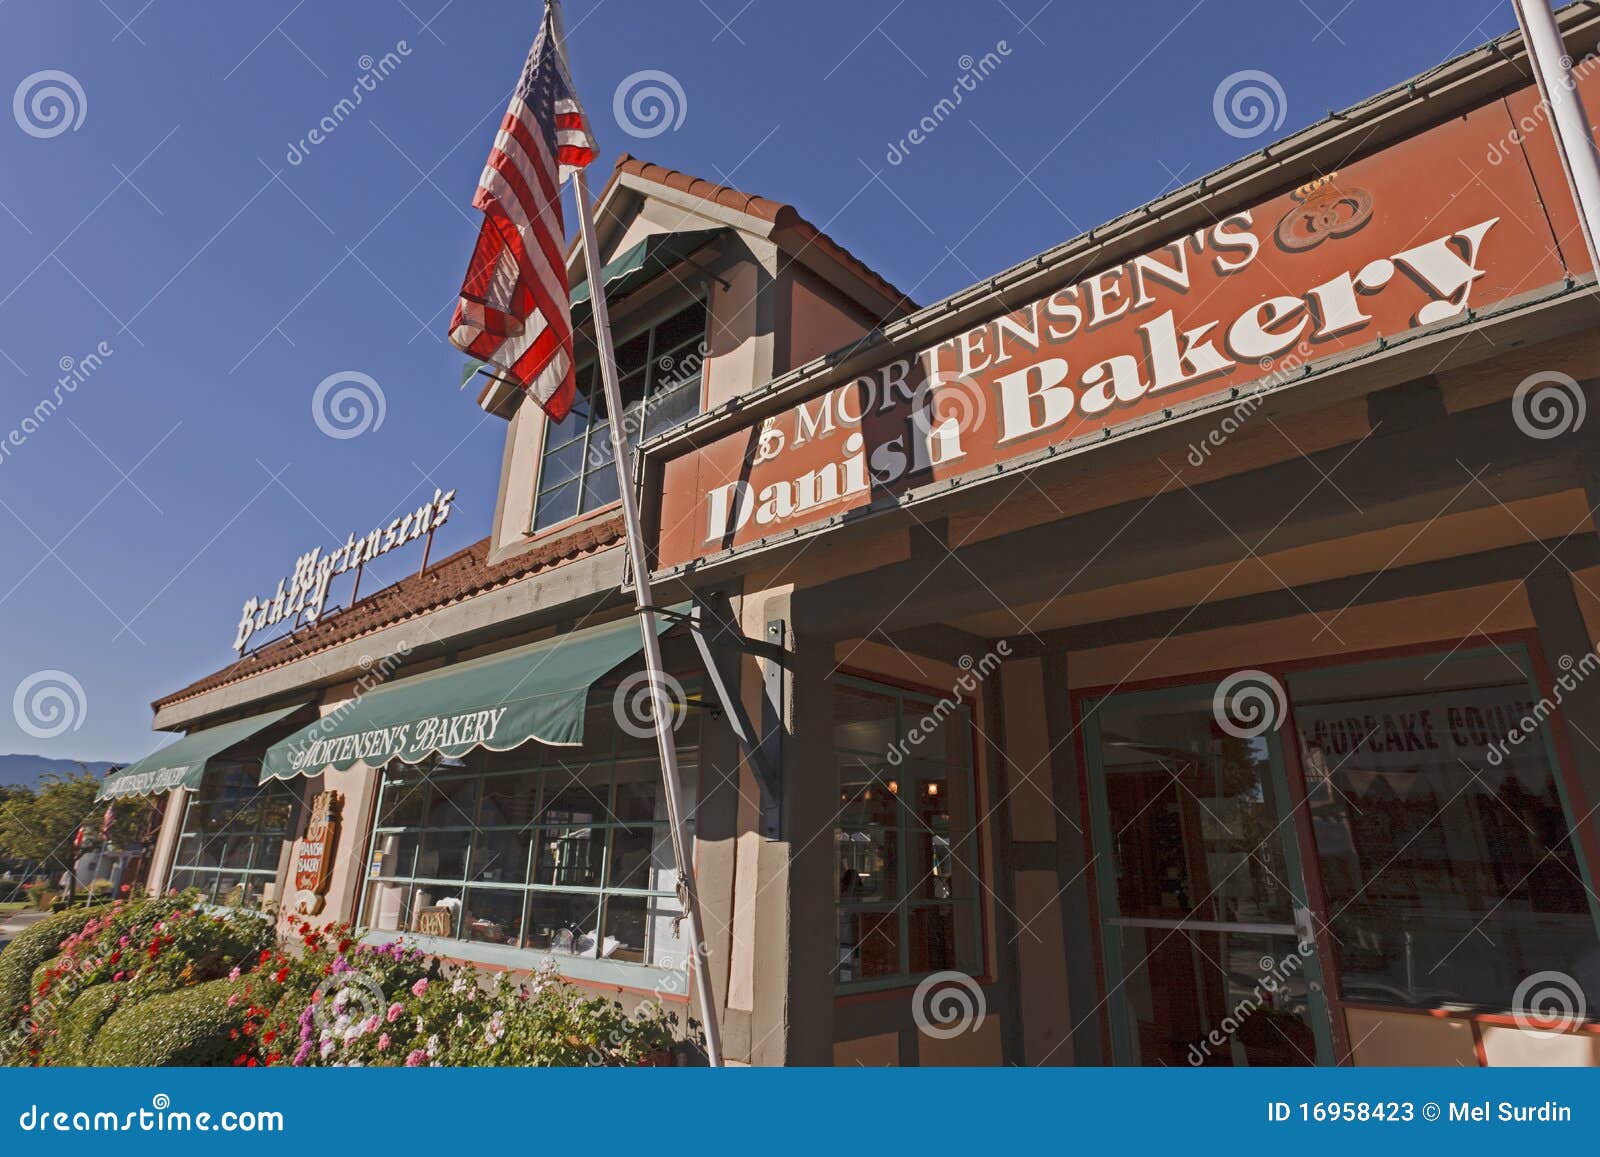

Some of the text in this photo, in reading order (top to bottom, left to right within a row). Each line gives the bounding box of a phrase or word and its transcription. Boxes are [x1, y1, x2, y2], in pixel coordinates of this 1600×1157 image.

[703, 216, 1501, 546] Danish Bakery
[794, 209, 1261, 446] MORTENSEN'S
[291, 488, 457, 591] Mortensen's
[291, 706, 508, 770] MORTENSEN'S BAKERY
